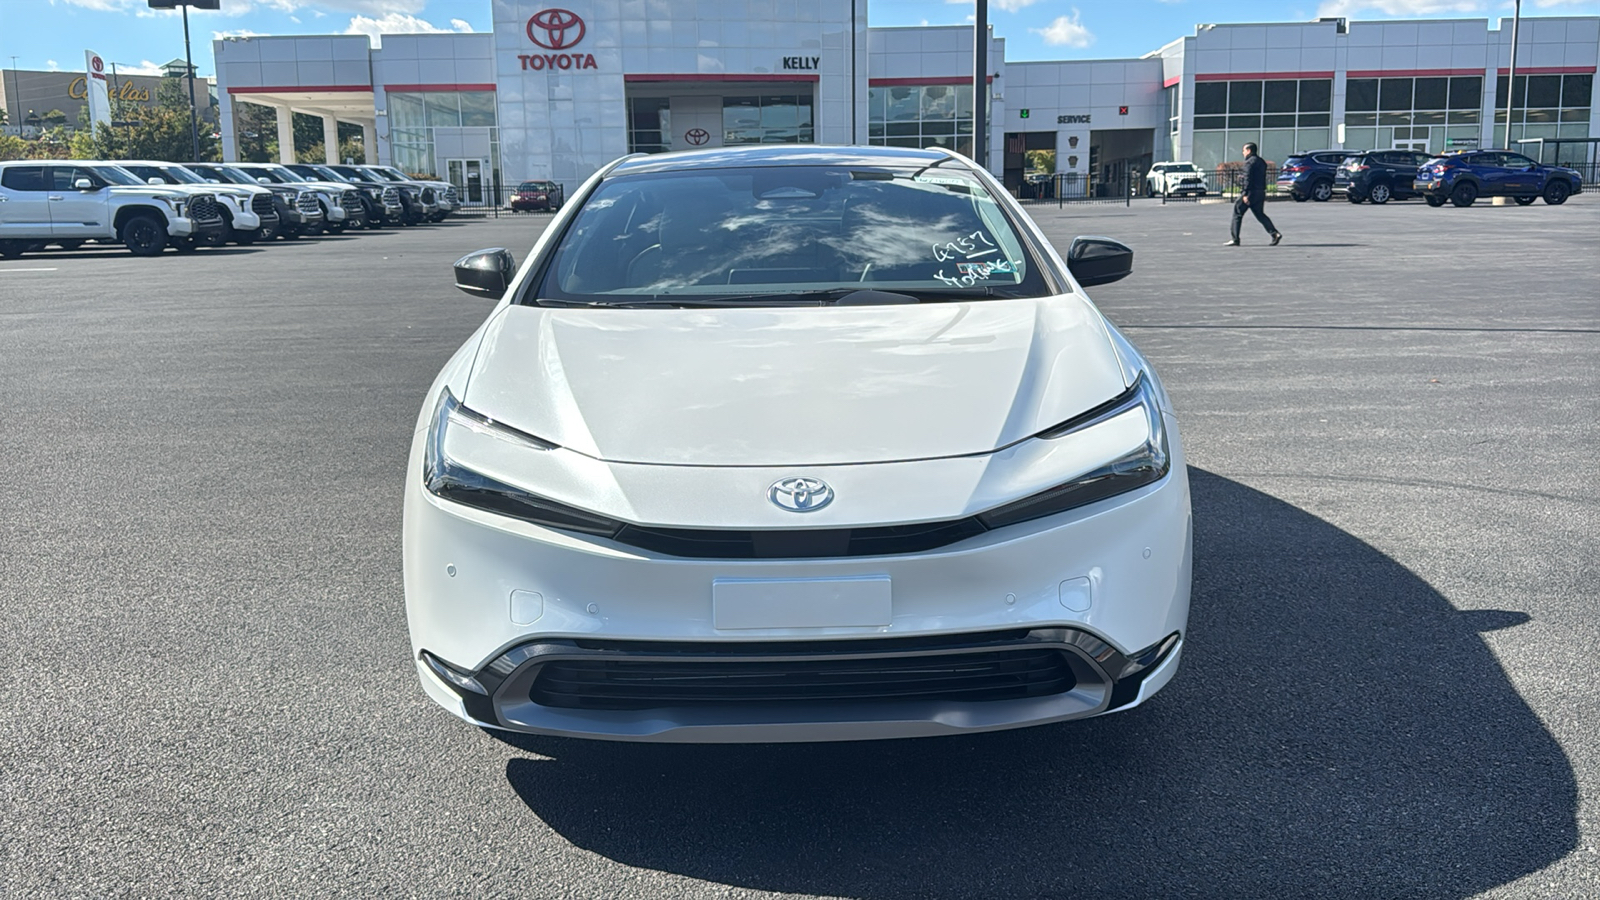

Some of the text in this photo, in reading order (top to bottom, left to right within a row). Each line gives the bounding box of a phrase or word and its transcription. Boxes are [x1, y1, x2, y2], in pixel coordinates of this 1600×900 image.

[517, 54, 598, 70] TOYOTA
[783, 56, 820, 70] KELLY
[68, 76, 150, 101] Cela's
[1057, 114, 1091, 124] SERVICE
